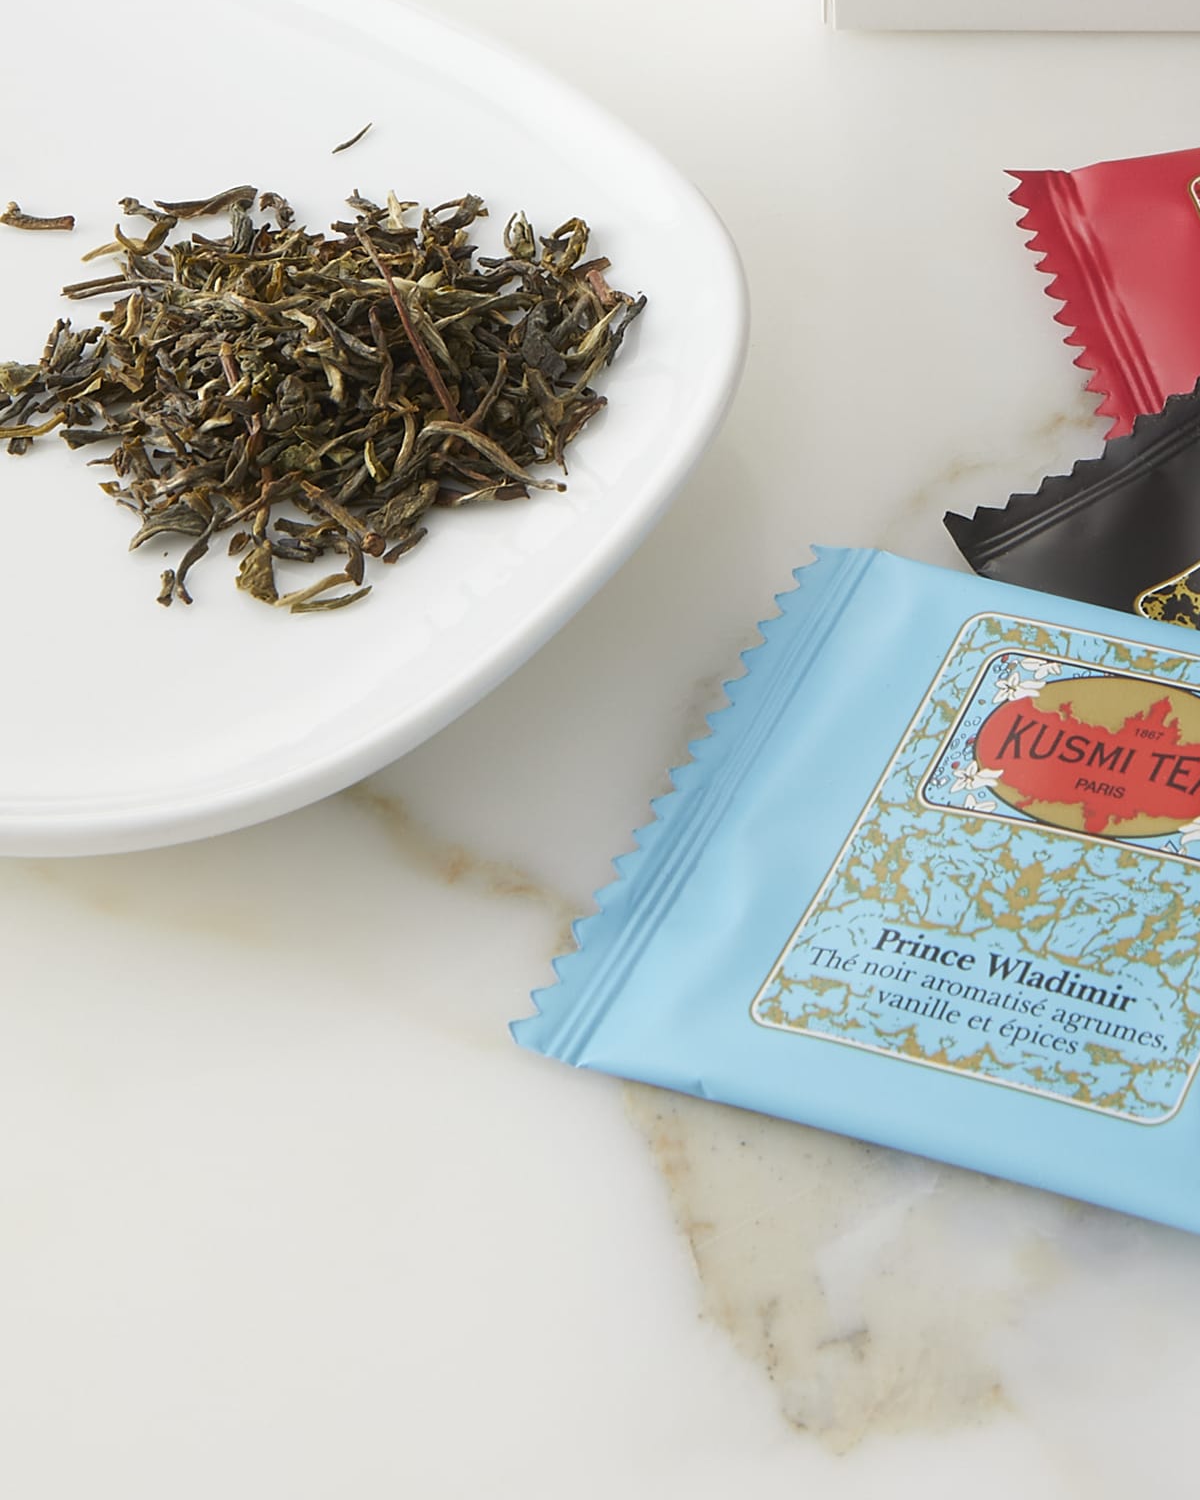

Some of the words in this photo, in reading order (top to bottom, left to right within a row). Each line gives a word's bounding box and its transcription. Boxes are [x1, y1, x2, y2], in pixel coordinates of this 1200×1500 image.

[995, 713, 1137, 774] KUSMI
[1134, 728, 1164, 741] 1867
[1075, 778, 1126, 799] PARIS
[809, 946, 860, 972] Thé
[861, 961, 917, 983] noir
[920, 973, 1048, 1017] aromatisé
[1051, 1007, 1168, 1051] agrumes,
[872, 928, 976, 971] Prince
[989, 952, 1137, 1012] Wladimir
[878, 990, 961, 1024] vanille
[967, 1014, 992, 1033] et
[998, 1018, 1079, 1055] épices
